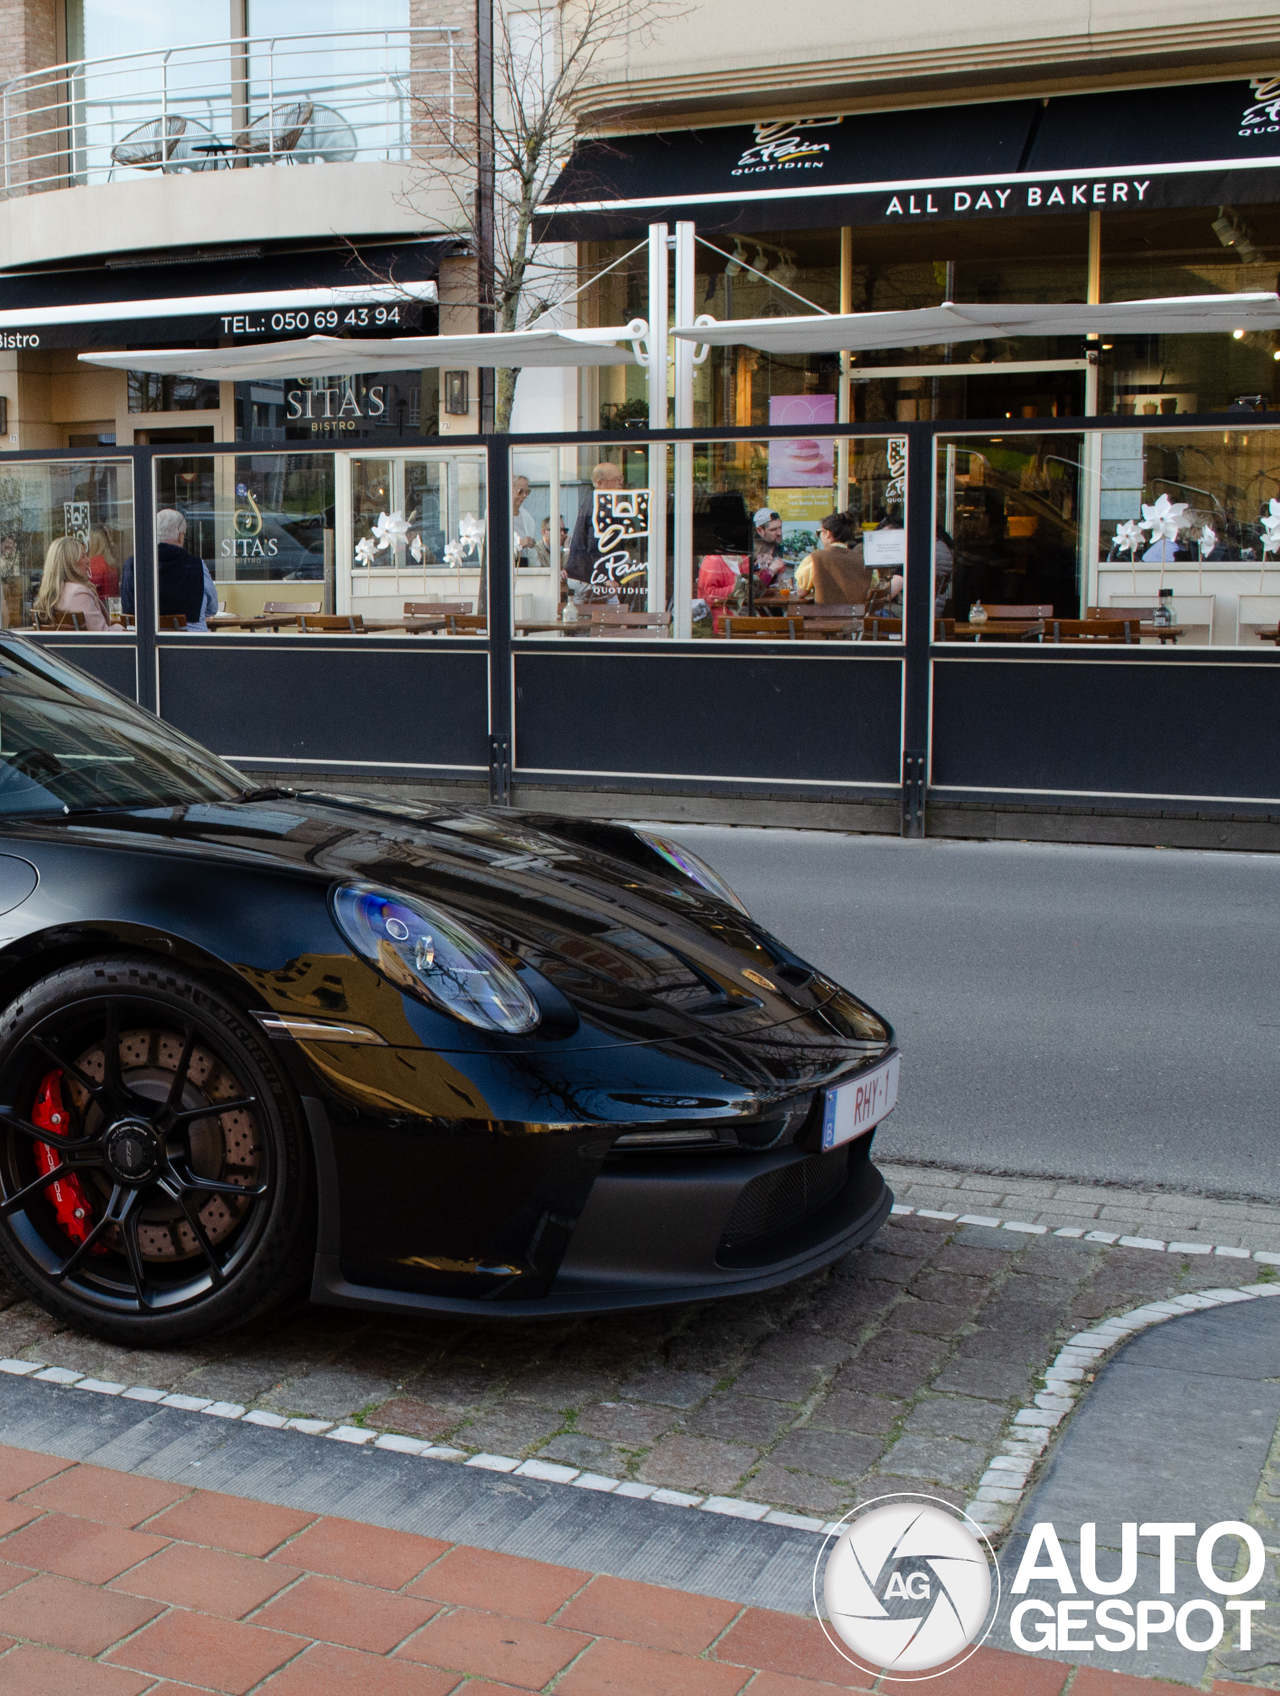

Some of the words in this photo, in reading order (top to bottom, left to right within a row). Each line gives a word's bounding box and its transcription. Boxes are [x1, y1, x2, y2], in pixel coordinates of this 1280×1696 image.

[741, 136, 830, 163] Pain
[730, 161, 824, 176] QUOTIDIEN
[885, 194, 939, 216] ALL
[953, 188, 1012, 212] DAY
[1027, 180, 1150, 207] BAKERY
[220, 315, 265, 333] TEL.:
[271, 311, 309, 331] 050
[313, 310, 338, 328] 69
[343, 308, 369, 326] 43
[375, 306, 400, 325] 94
[286, 385, 385, 419] SITA'S
[311, 420, 356, 432] BISTRO
[221, 537, 278, 557] SITA'S
[593, 550, 649, 581] Pain
[213, 1007, 285, 1095] MICHELIN
[826, 1122, 833, 1141] B
